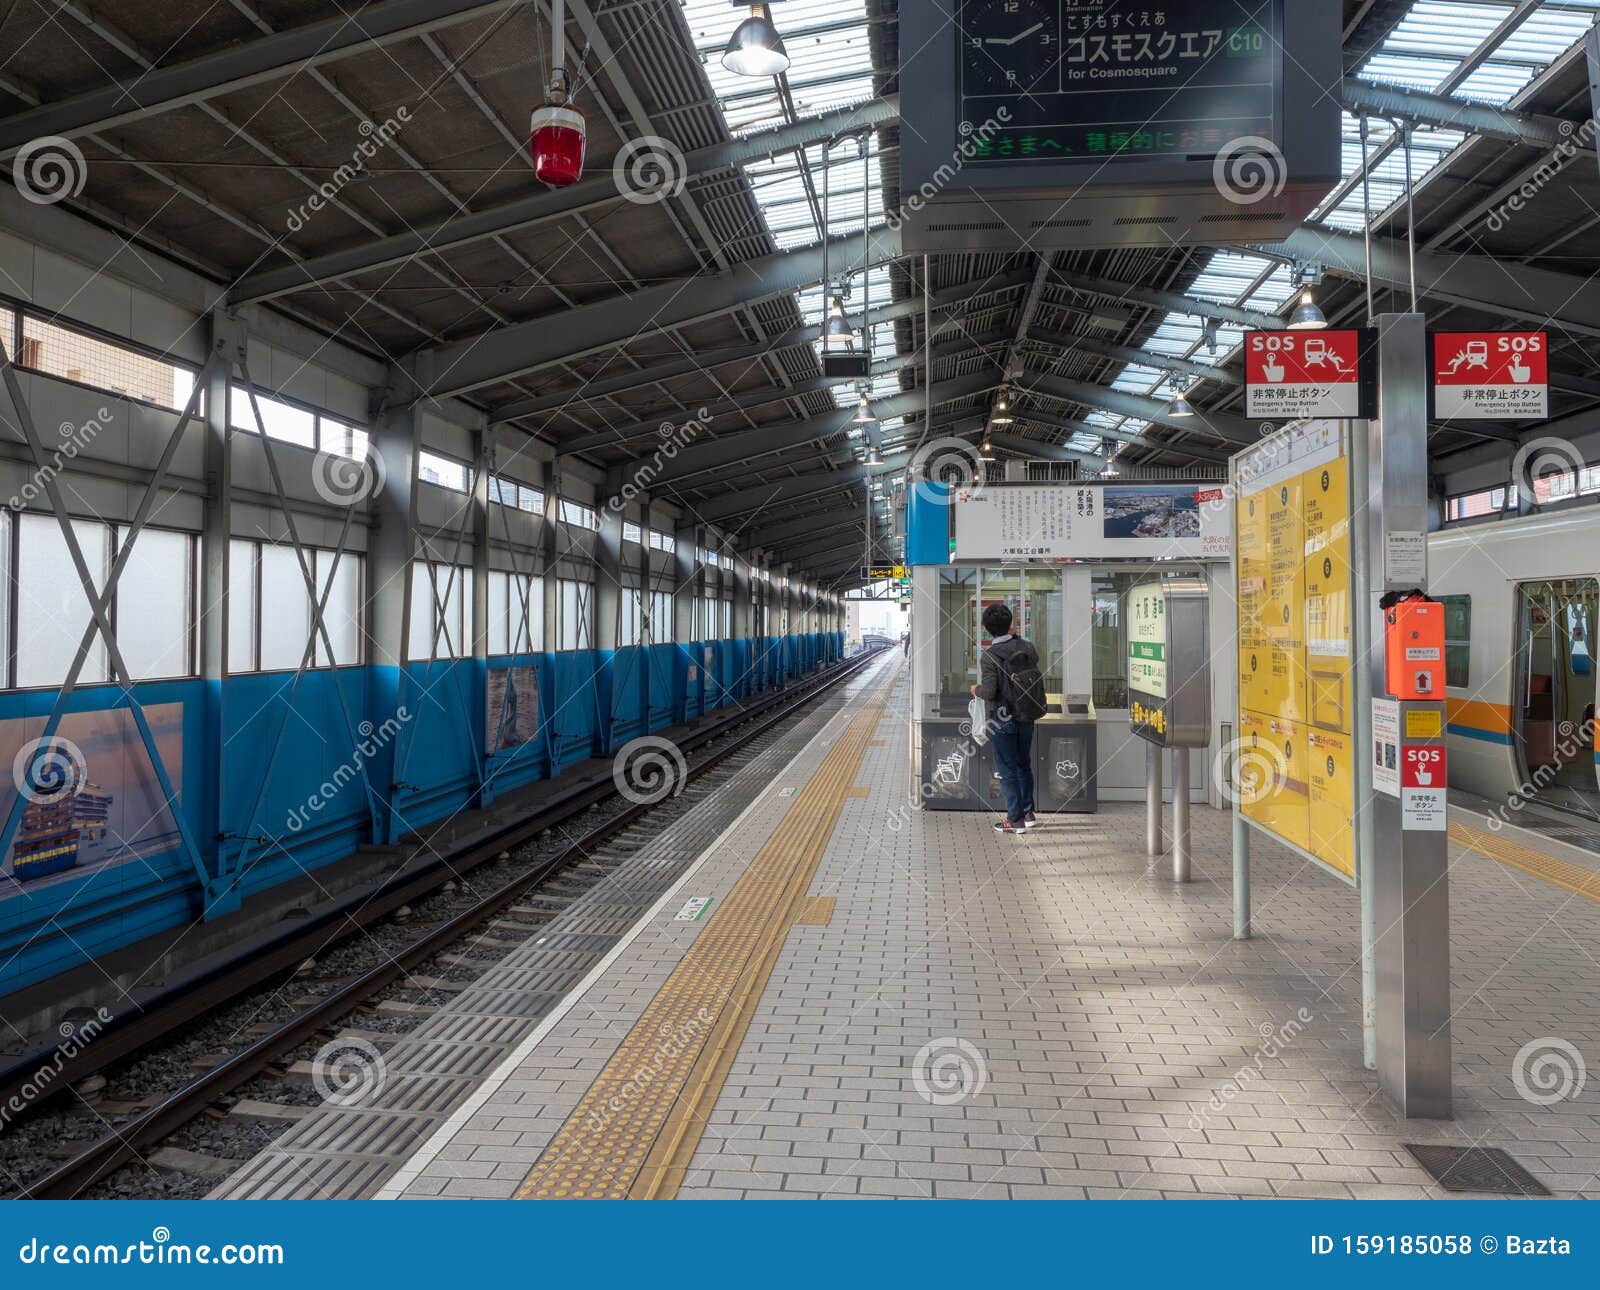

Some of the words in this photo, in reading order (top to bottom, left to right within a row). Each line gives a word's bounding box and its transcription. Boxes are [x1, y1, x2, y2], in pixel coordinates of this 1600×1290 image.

[1004, 2, 1019, 12] 12
[1067, 11, 1166, 29] こすもすくえあ
[1040, 34, 1050, 44] 3
[1229, 33, 1262, 52] C10
[1067, 30, 1222, 64] コスモスクエア
[1006, 70, 1016, 80] 6
[1068, 68, 1086, 79] for
[1089, 66, 1178, 81] Cosmosquare
[1252, 336, 1295, 351] SOS
[1497, 336, 1541, 352] SOS
[1253, 388, 1331, 399] 非常停止ボタン
[1463, 389, 1541, 400] 非常停止ボタン
[1407, 749, 1441, 762] SOS
